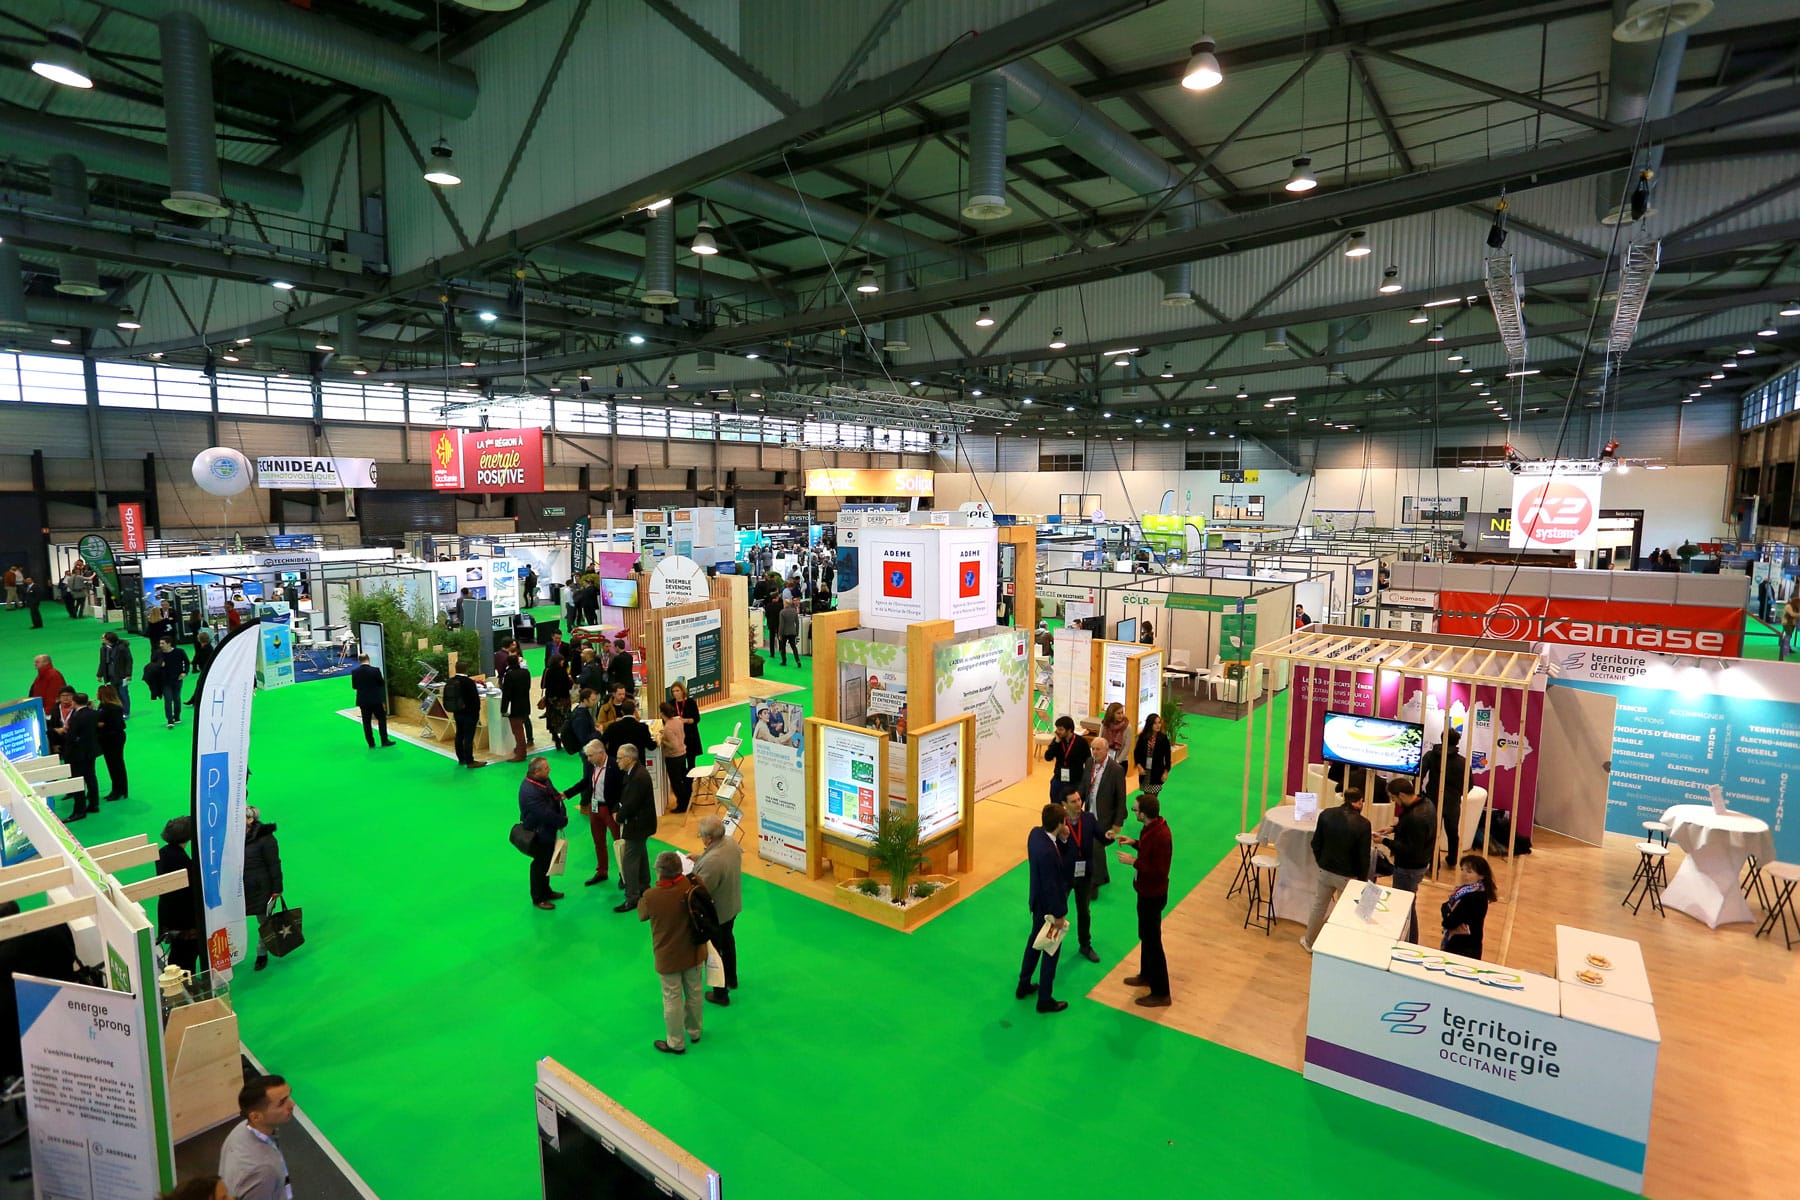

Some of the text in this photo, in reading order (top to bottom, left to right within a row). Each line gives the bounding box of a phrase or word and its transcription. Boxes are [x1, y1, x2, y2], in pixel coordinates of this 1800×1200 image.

[477, 441, 485, 449] LA
[257, 460, 336, 473] ECHNIDEAL
[480, 450, 521, 472] énergie
[477, 468, 525, 485] POSITIVE
[966, 510, 990, 519] PIE
[1522, 497, 1589, 525] K2
[1535, 528, 1579, 540] systems
[883, 549, 912, 558] ADEME
[960, 549, 980, 557] ADEME
[273, 556, 313, 564] TECHNIDEAL
[492, 561, 515, 573] BRL
[1591, 652, 1646, 667] territoire
[1590, 662, 1647, 677] d'énergie
[1589, 672, 1626, 681] OCCITANIE
[1634, 716, 1665, 725] ACTIONS
[1654, 729, 1701, 742] D'ÉNERGIE
[1706, 727, 1717, 760] FORCE
[1735, 746, 1778, 757] CONSEILS
[1667, 763, 1709, 775] ÉLECTRICITÉ
[1610, 769, 1713, 791] TRANSITION ÉNERGÉTI
[1612, 780, 1642, 790] RÉSEAUX
[67, 1000, 108, 1017] energie
[93, 1017, 131, 1037] sprong
[1443, 1007, 1558, 1057] territoire
[1441, 1028, 1560, 1079] d'énergie
[1439, 1048, 1517, 1082] OCCITANIE
